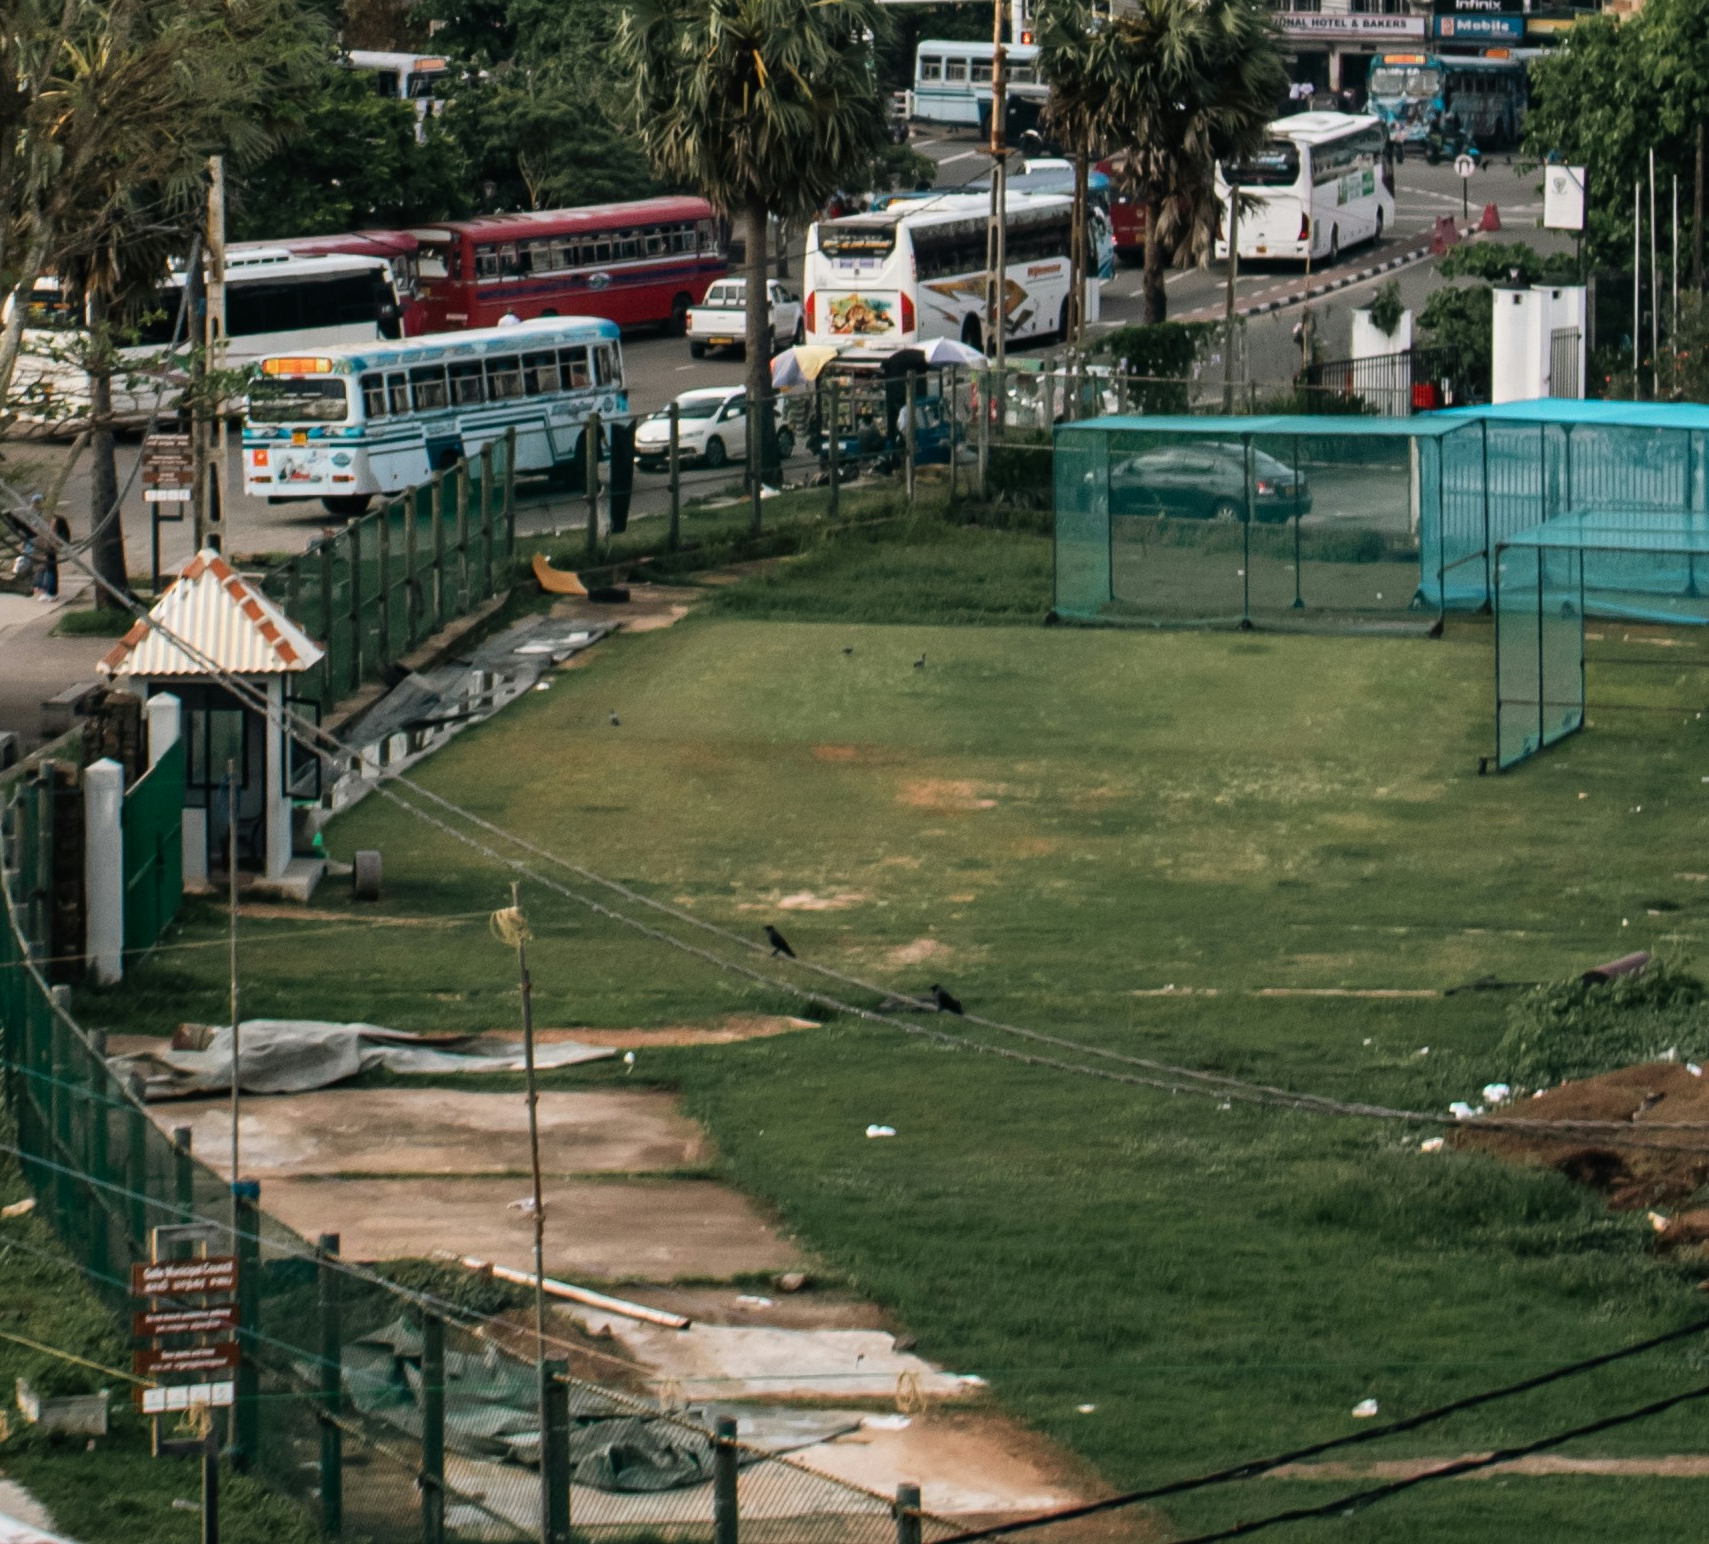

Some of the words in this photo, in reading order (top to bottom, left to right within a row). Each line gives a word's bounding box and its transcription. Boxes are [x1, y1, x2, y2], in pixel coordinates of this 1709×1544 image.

[1311, 18, 1347, 29] HOTEL
[1351, 18, 1359, 29] &
[1362, 18, 1407, 29] BAKERS
[1456, 18, 1509, 32] Mobile
